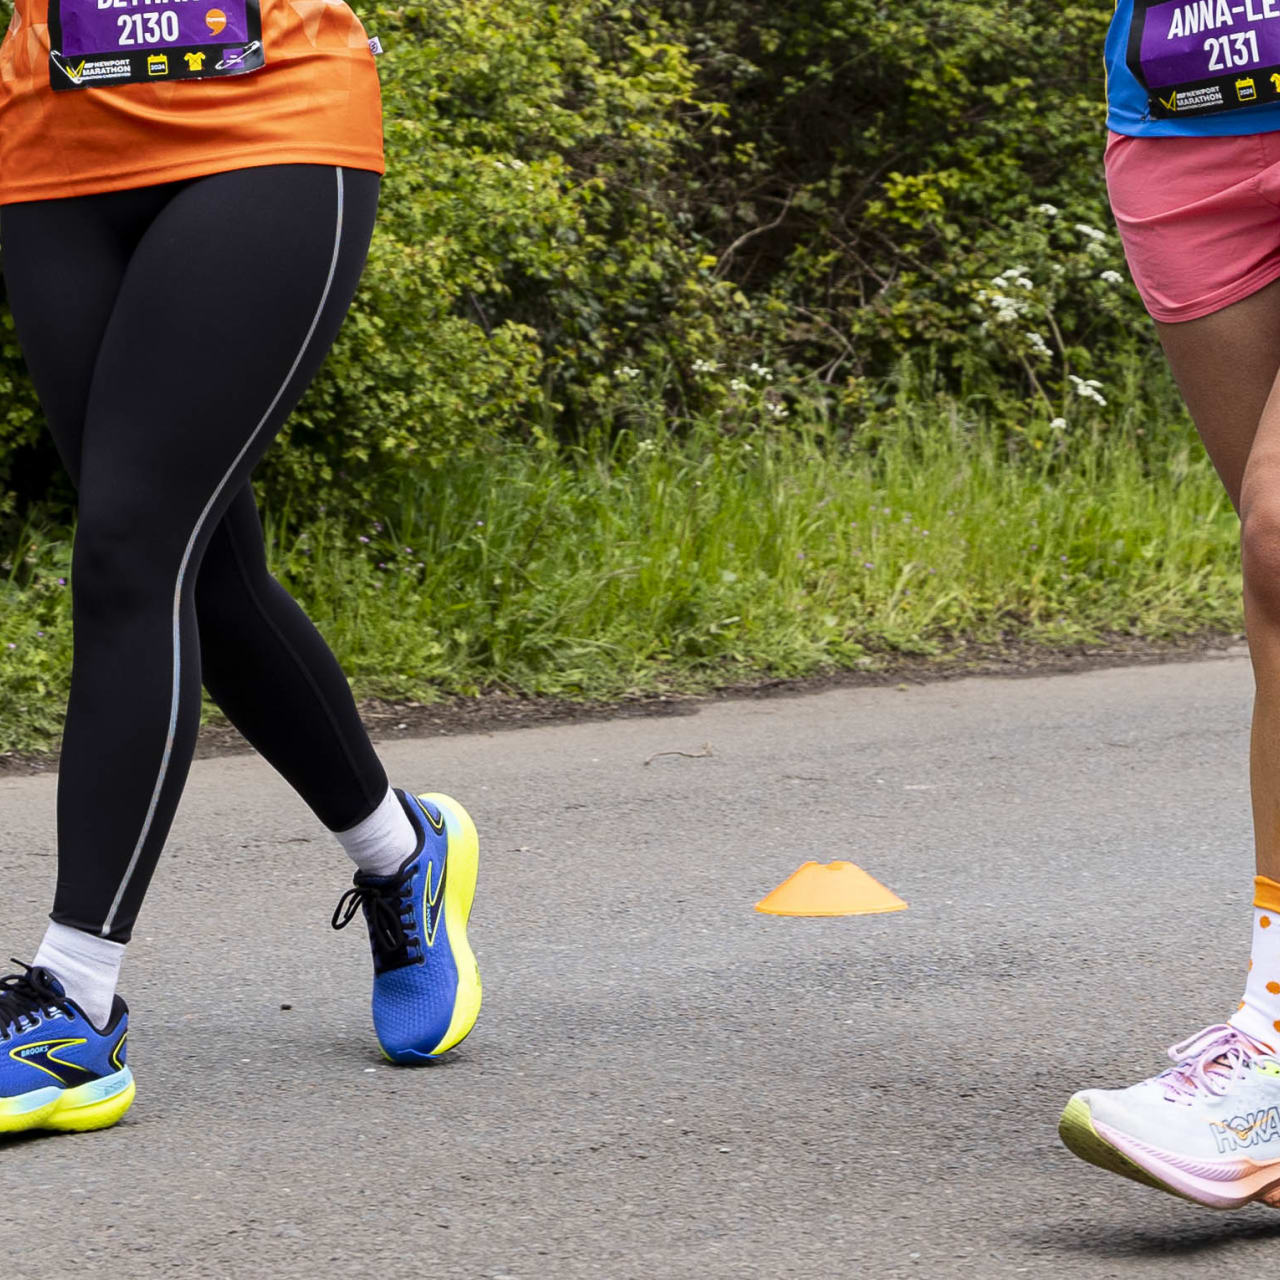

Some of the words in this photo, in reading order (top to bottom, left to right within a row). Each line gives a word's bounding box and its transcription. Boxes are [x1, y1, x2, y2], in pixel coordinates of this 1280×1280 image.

[116, 10, 180, 46] 2130
[1203, 30, 1260, 71] 2131
[82, 65, 131, 76] MARATHON
[1176, 92, 1222, 106] MARATHON
